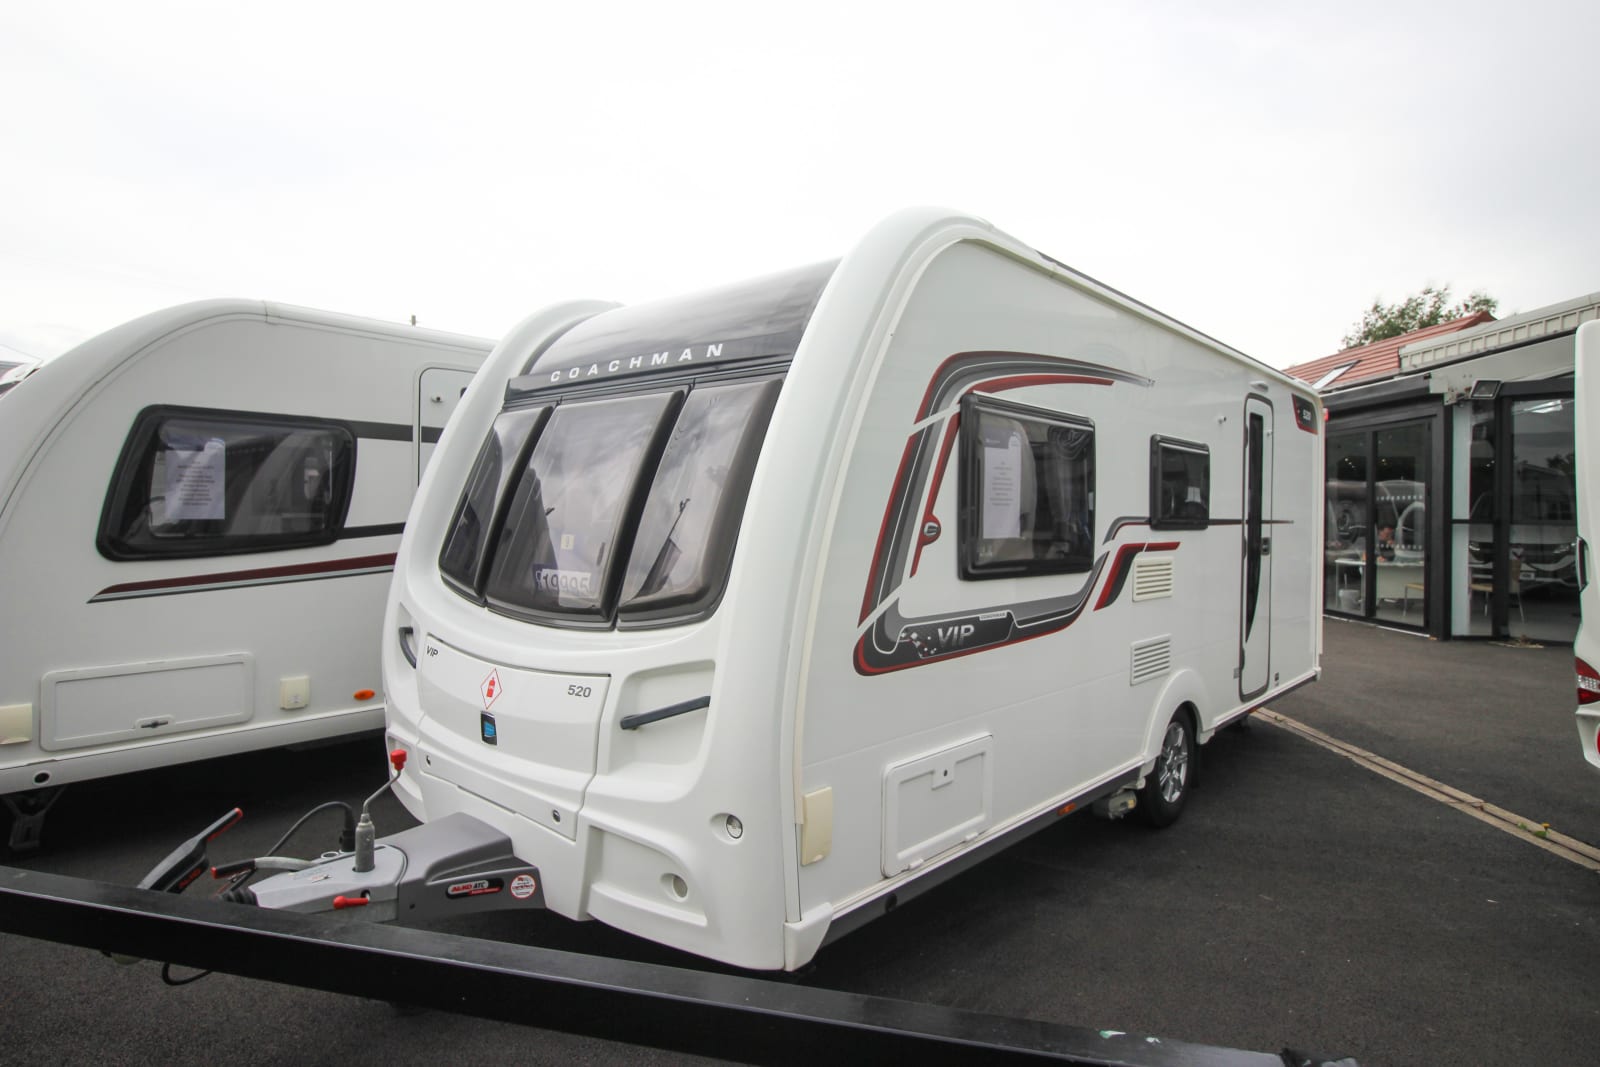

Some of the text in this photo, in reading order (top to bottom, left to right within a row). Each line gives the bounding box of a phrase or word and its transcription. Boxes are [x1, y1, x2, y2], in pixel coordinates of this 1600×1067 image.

[550, 343, 723, 382] COACHMAN
[937, 624, 975, 648] VIP
[426, 645, 439, 657] VIP
[567, 684, 592, 698] 520
